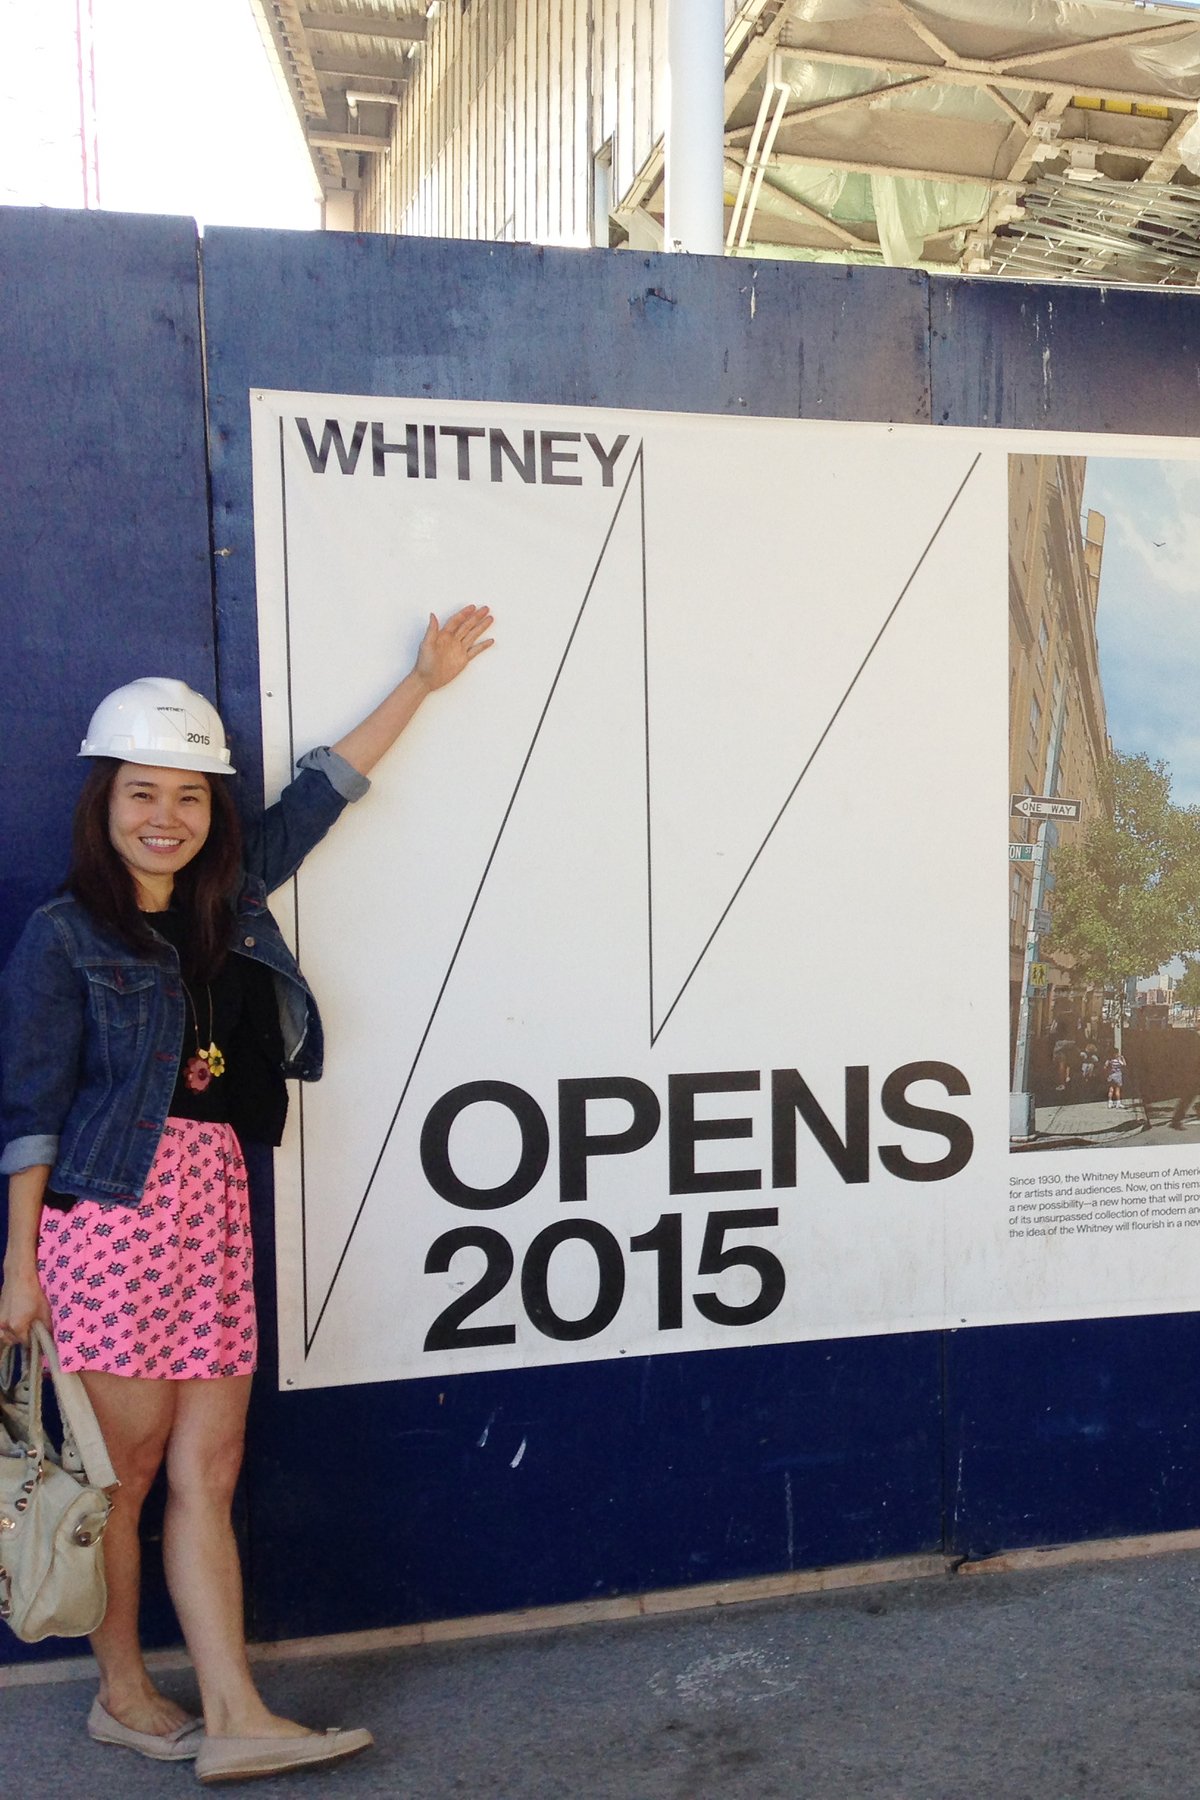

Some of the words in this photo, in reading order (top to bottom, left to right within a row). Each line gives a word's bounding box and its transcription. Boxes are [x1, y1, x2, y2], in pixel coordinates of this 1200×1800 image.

[294, 417, 630, 487] WHITNEY
[187, 733, 210, 745] 2015
[1022, 803, 1042, 812] ONE
[1051, 805, 1072, 815] WAY
[1009, 846, 1021, 858] ON
[419, 1059, 975, 1211] OPENS
[1009, 1176, 1035, 1186] Since
[1038, 1174, 1063, 1184] 1930,
[1065, 1173, 1080, 1183] the
[1082, 1172, 1119, 1182] Whitney
[1121, 1170, 1159, 1179] Museum
[1161, 1168, 1170, 1177] of
[1009, 1189, 1022, 1198] for
[1024, 1188, 1053, 1197] artists
[1055, 1186, 1072, 1196] and
[1074, 1185, 1123, 1194] audiences.
[1126, 1183, 1148, 1192] Now,
[1164, 1180, 1180, 1189] this
[1017, 1203, 1037, 1211] new
[1121, 1196, 1146, 1205] home
[1149, 1194, 1166, 1203] that
[1168, 1193, 1182, 1202] will
[1009, 1215, 1018, 1224] of
[1021, 1215, 1031, 1224] its
[1034, 1211, 1093, 1224] unsurpassed
[1095, 1209, 1138, 1219] collection
[1140, 1207, 1149, 1216] of
[1151, 1206, 1186, 1216] modern
[1009, 1228, 1024, 1237] the
[1026, 1227, 1046, 1236] idea
[1047, 1225, 1057, 1235] of
[1060, 1225, 1074, 1234] the
[1076, 1223, 1113, 1233] Whitney
[1115, 1221, 1129, 1231] will
[1132, 1219, 1164, 1230] flourish
[1167, 1219, 1175, 1228] in
[422, 1207, 786, 1353] 2015
